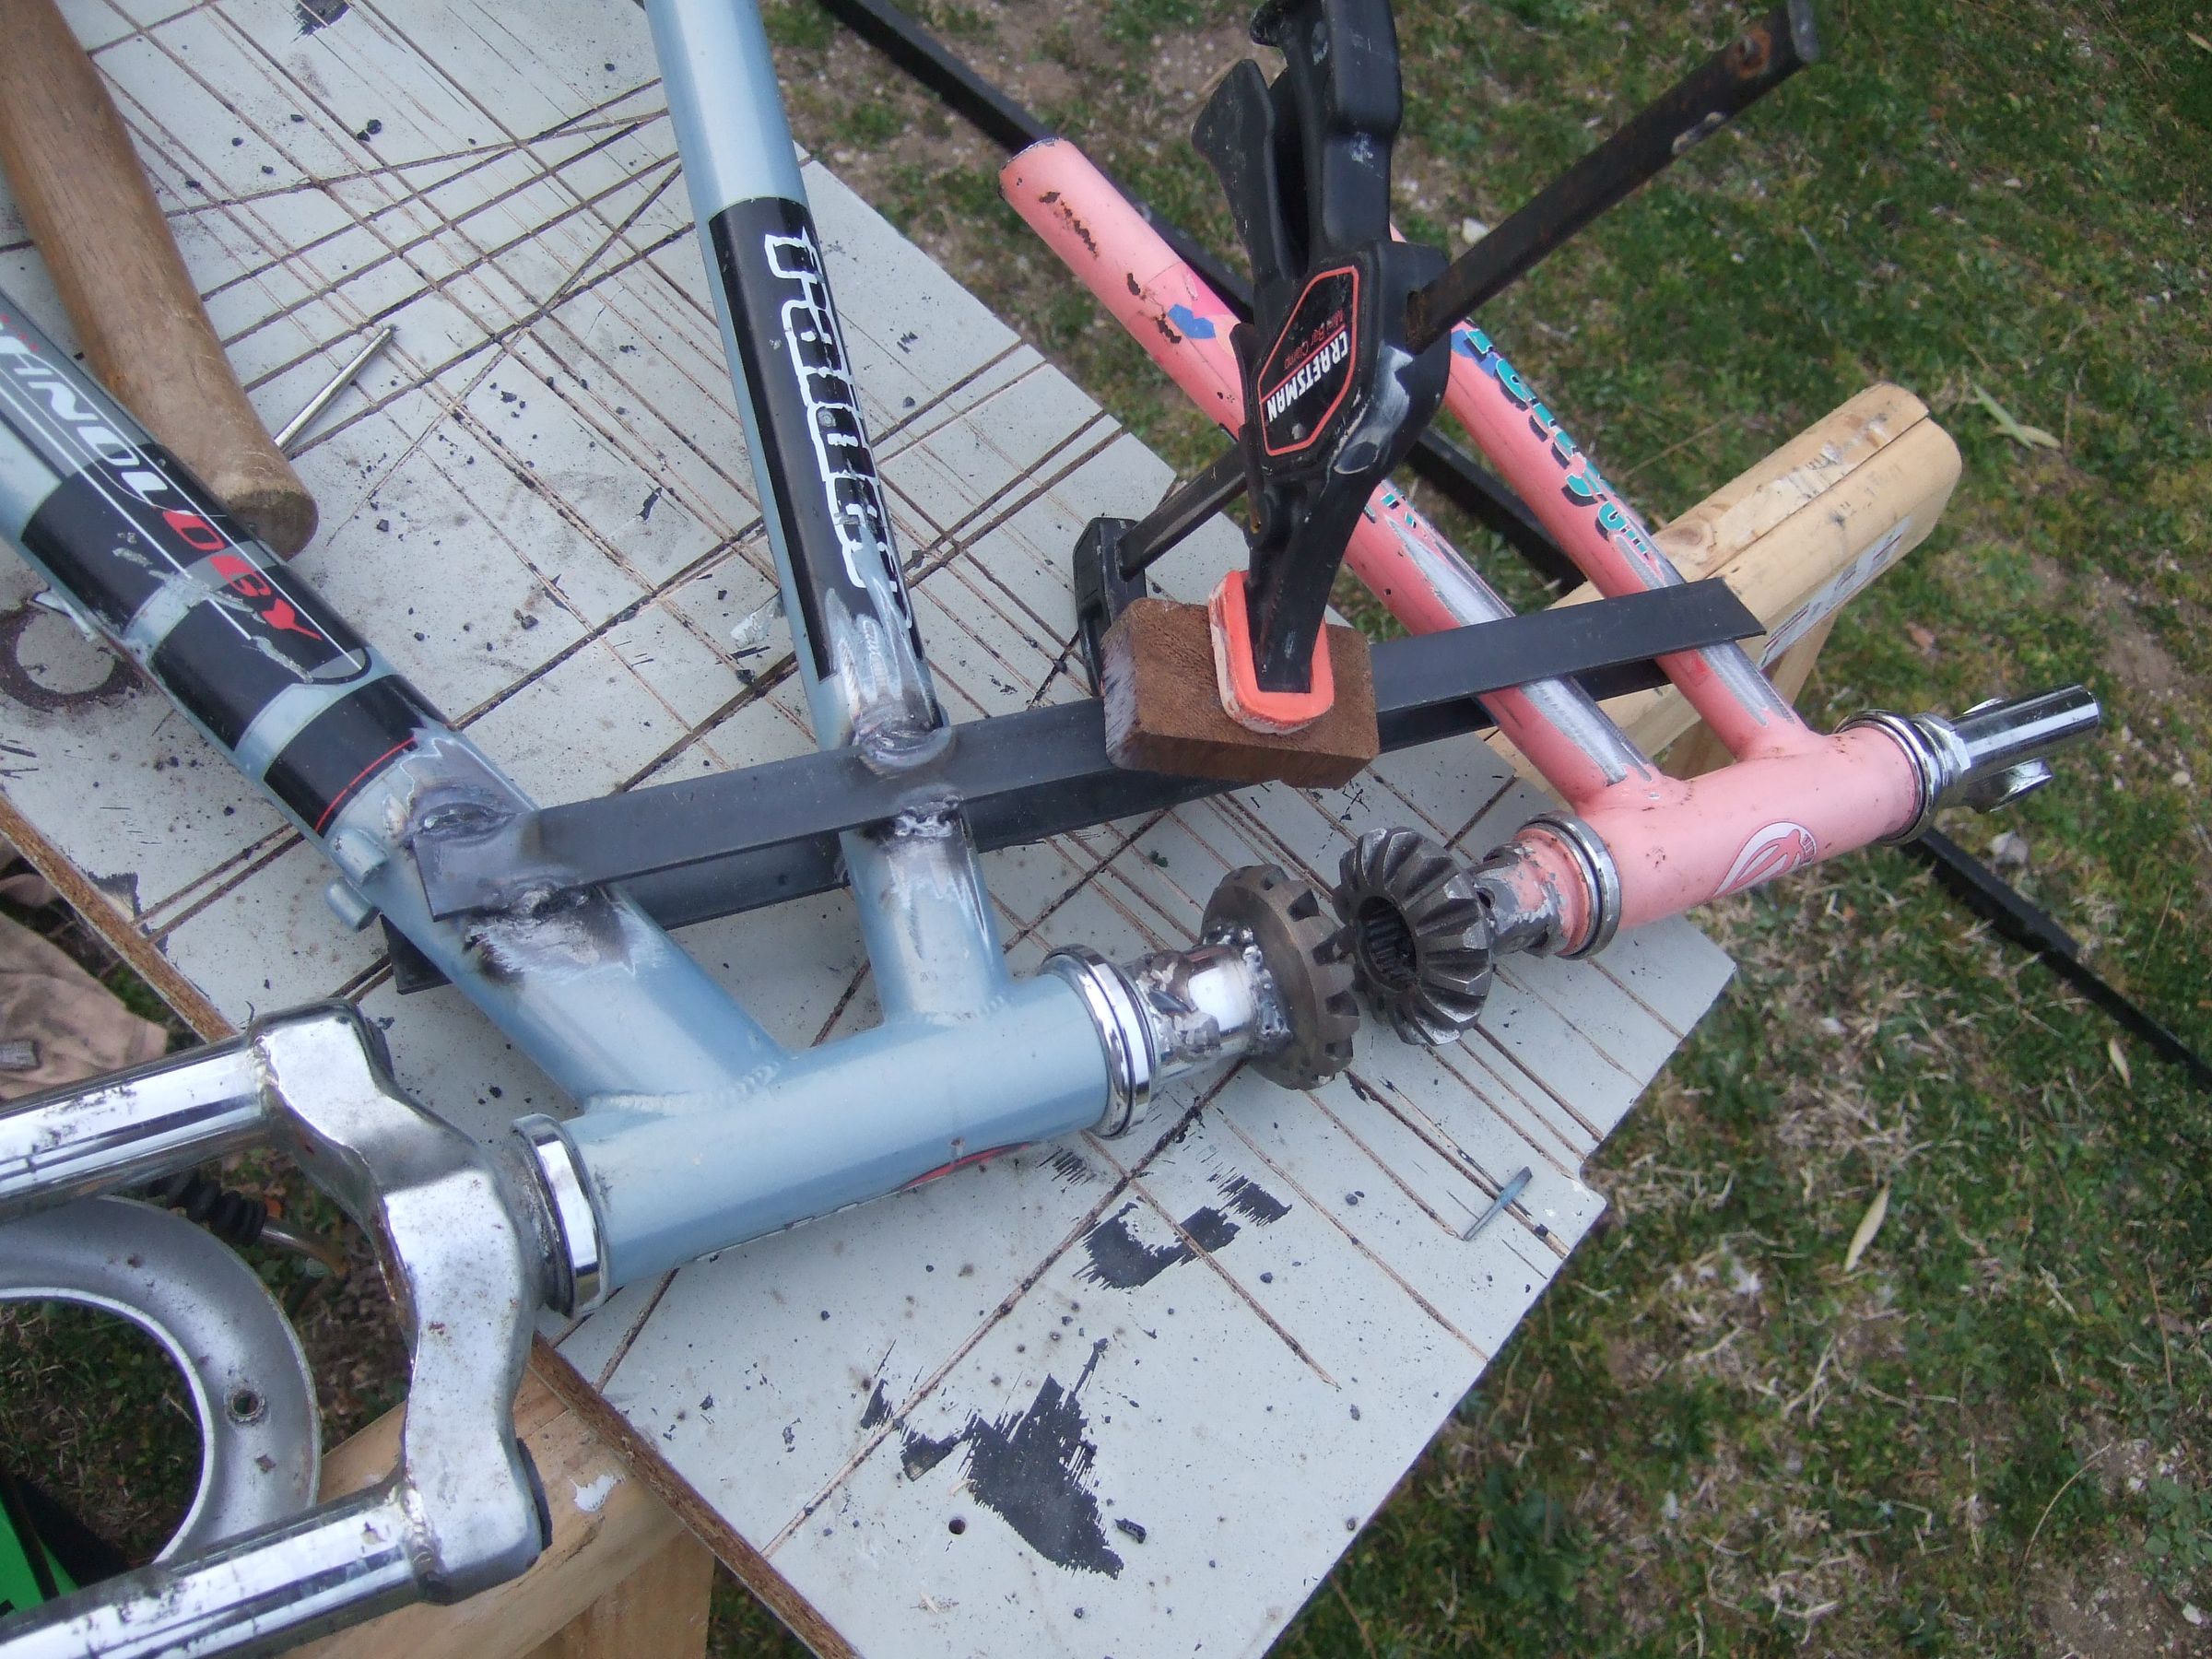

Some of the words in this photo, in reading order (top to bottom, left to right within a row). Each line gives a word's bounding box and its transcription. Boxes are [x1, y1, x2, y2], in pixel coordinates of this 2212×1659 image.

[1284, 340, 1310, 370] Clamp
[1311, 323, 1326, 346] Bar
[1266, 331, 1348, 422] CRAFTSMAN
[0, 328, 322, 641] HNOLOGY
